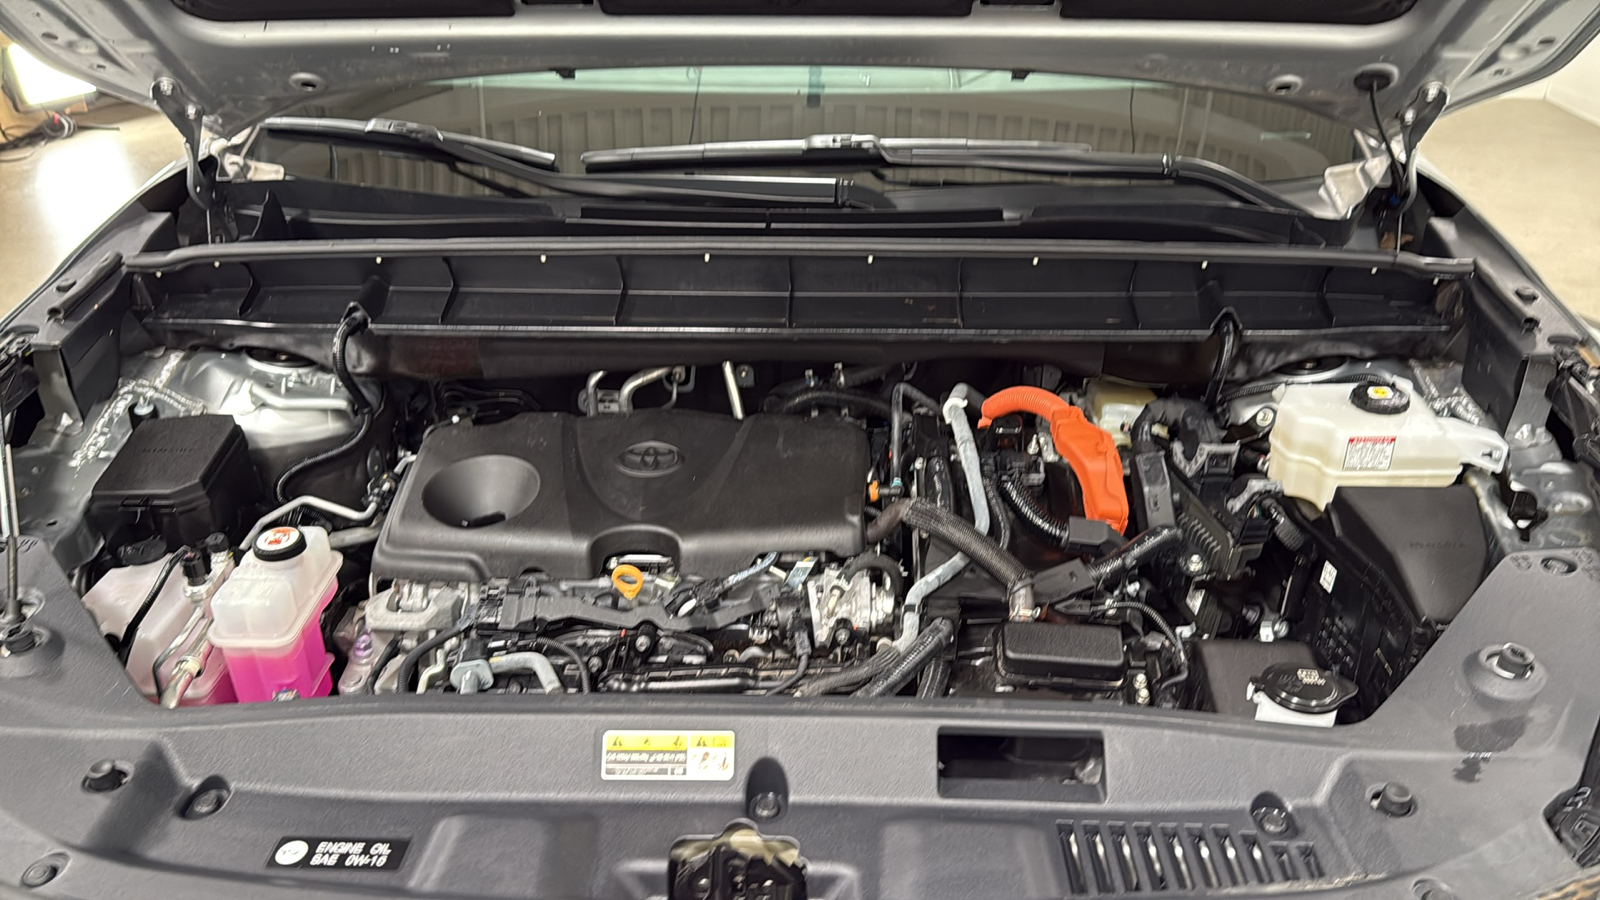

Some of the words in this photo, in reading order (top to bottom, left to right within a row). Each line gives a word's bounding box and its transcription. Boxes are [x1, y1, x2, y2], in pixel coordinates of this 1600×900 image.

[315, 841, 366, 855] ENGINE
[369, 842, 392, 855] OIL
[309, 853, 340, 866] SAE
[344, 854, 388, 868] 0W-16
